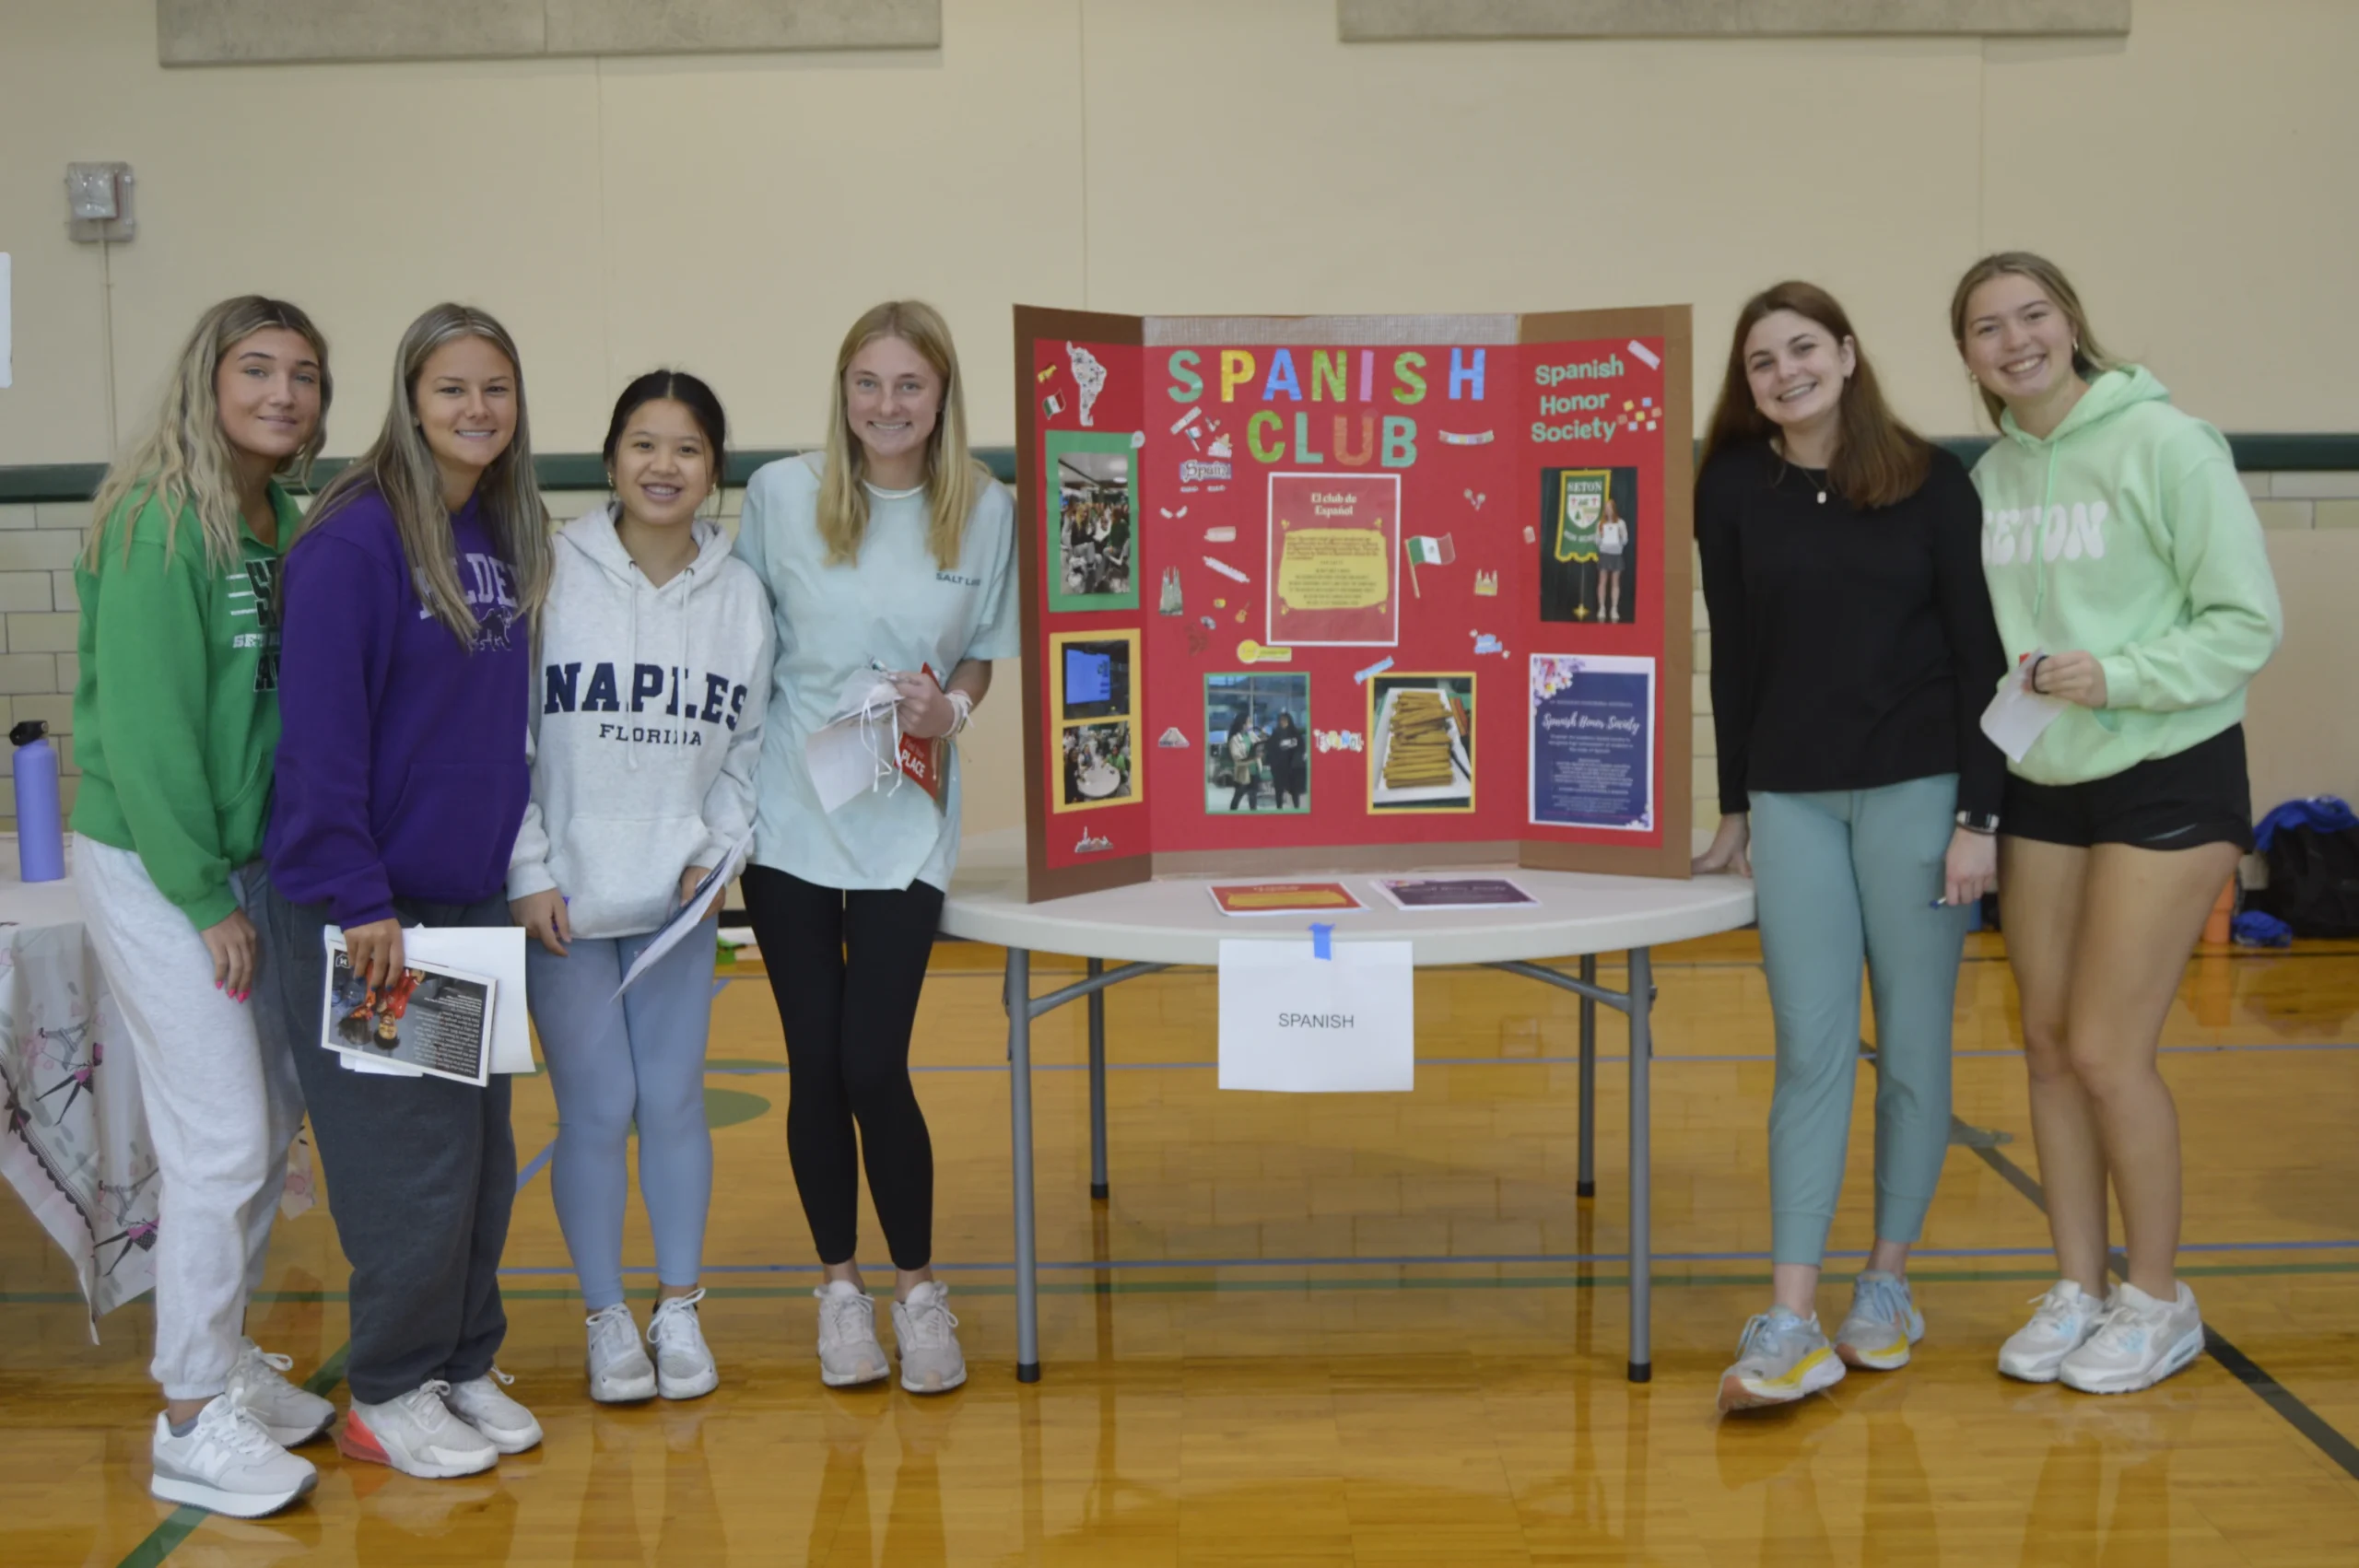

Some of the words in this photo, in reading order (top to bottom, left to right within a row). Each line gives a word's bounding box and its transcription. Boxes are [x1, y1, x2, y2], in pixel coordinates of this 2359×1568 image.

[1168, 348, 1485, 404] SPANISH
[1534, 353, 1625, 387] Spanish
[1540, 392, 1611, 416] Honor
[1248, 411, 1417, 467] CLUB
[1531, 416, 1617, 443] Society
[1182, 460, 1229, 483] Spain
[1322, 493, 1344, 504] club
[1344, 494, 1356, 504] de
[1315, 505, 1354, 519] Español
[936, 572, 964, 585] SALT
[544, 661, 748, 732] NAPLES
[599, 722, 702, 746] FLORIDA
[900, 749, 926, 778] PLACE
[1278, 1012, 1355, 1029] SPANISH
